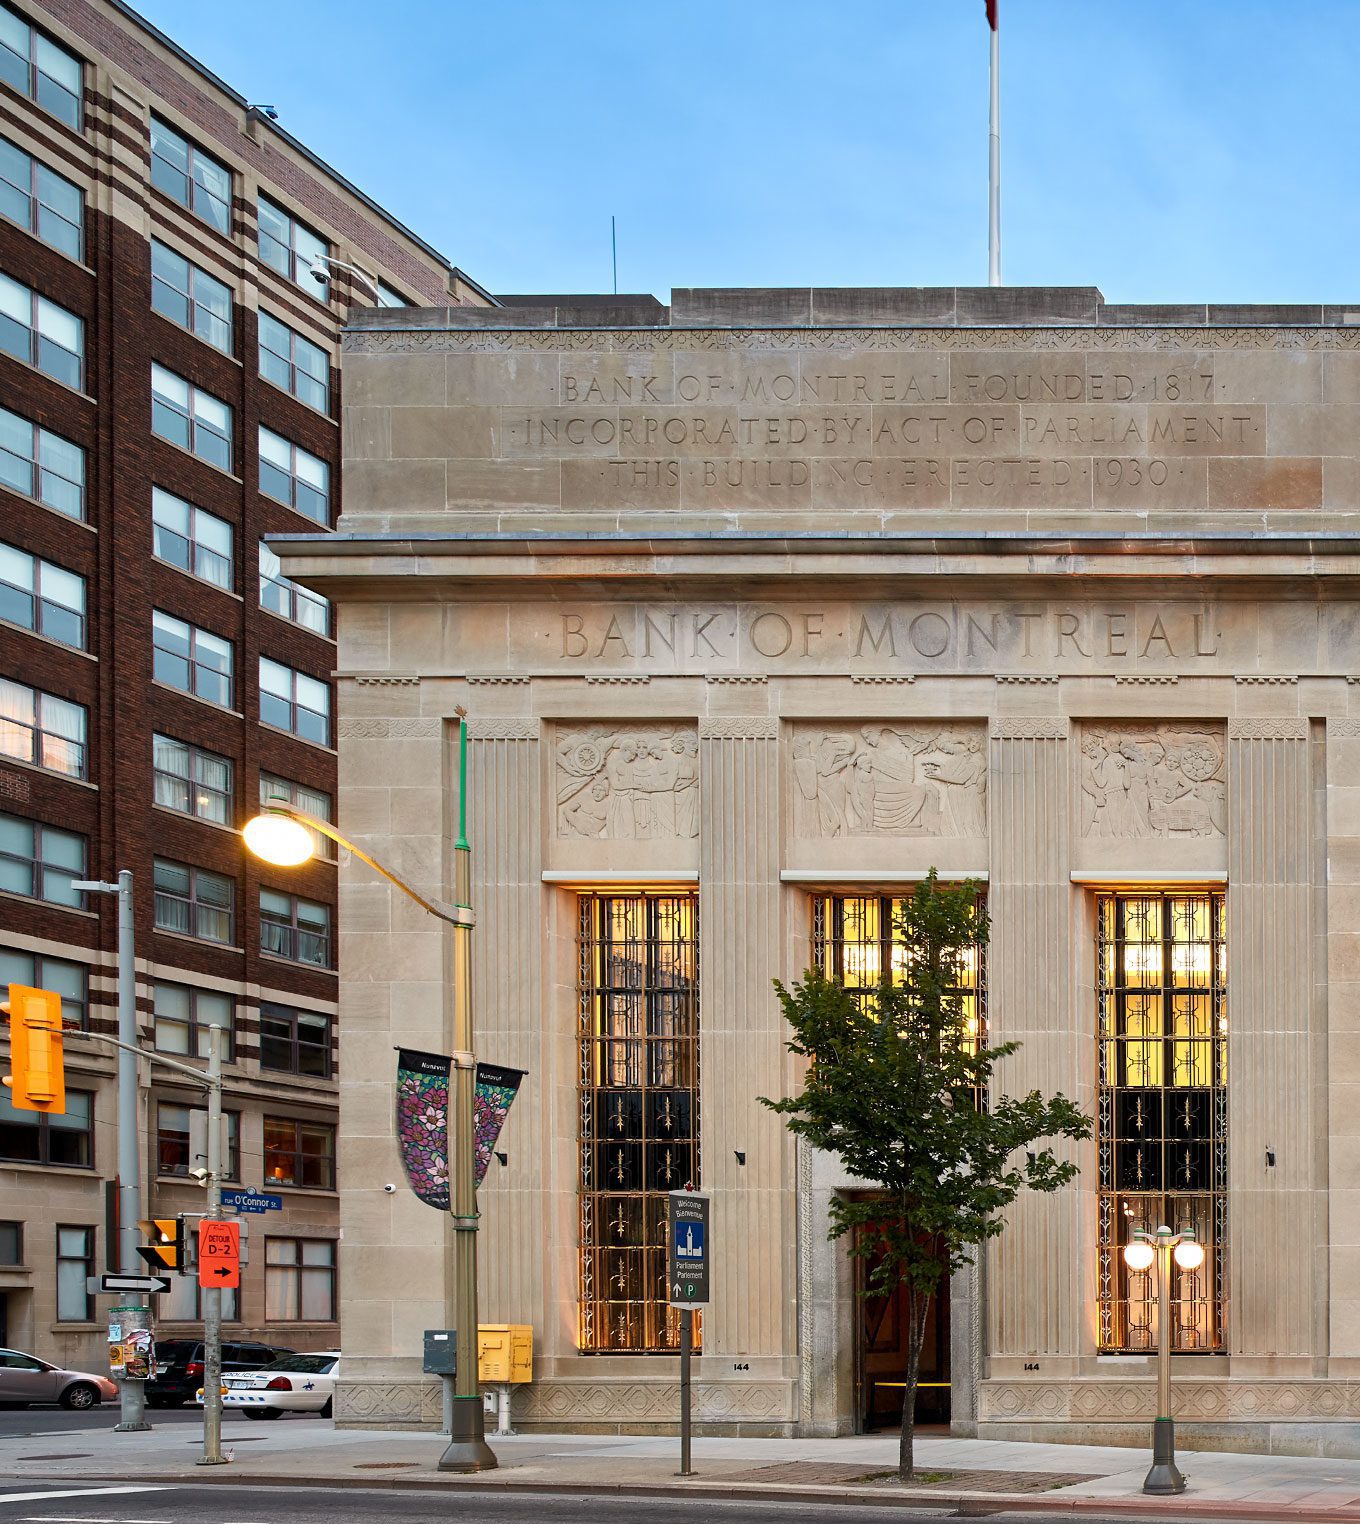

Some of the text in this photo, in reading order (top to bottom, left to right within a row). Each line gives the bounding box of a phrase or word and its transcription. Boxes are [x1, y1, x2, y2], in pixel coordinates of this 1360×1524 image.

[563, 374, 1214, 402] BANK OF MONTREAL FOUNDED 1817
[524, 416, 1251, 445] INCORPORATED BY ACT OF PARLIAMENT
[608, 459, 1169, 488] THIS BUILDING ERECTED 1930
[558, 612, 1219, 660] BANK OF MONTREAL
[421, 1062, 446, 1072] Nunavut
[480, 1072, 502, 1081] Nunavut
[234, 1195, 269, 1207] O'Connor
[677, 1200, 702, 1210] Welcome
[675, 1210, 704, 1220] Bienvenue
[208, 1235, 230, 1243] DETOUR
[208, 1245, 231, 1255] D-2
[676, 1261, 704, 1270] Parliament
[676, 1271, 703, 1279] Parlement
[733, 1363, 750, 1371] 144
[1024, 1363, 1039, 1371] 144
